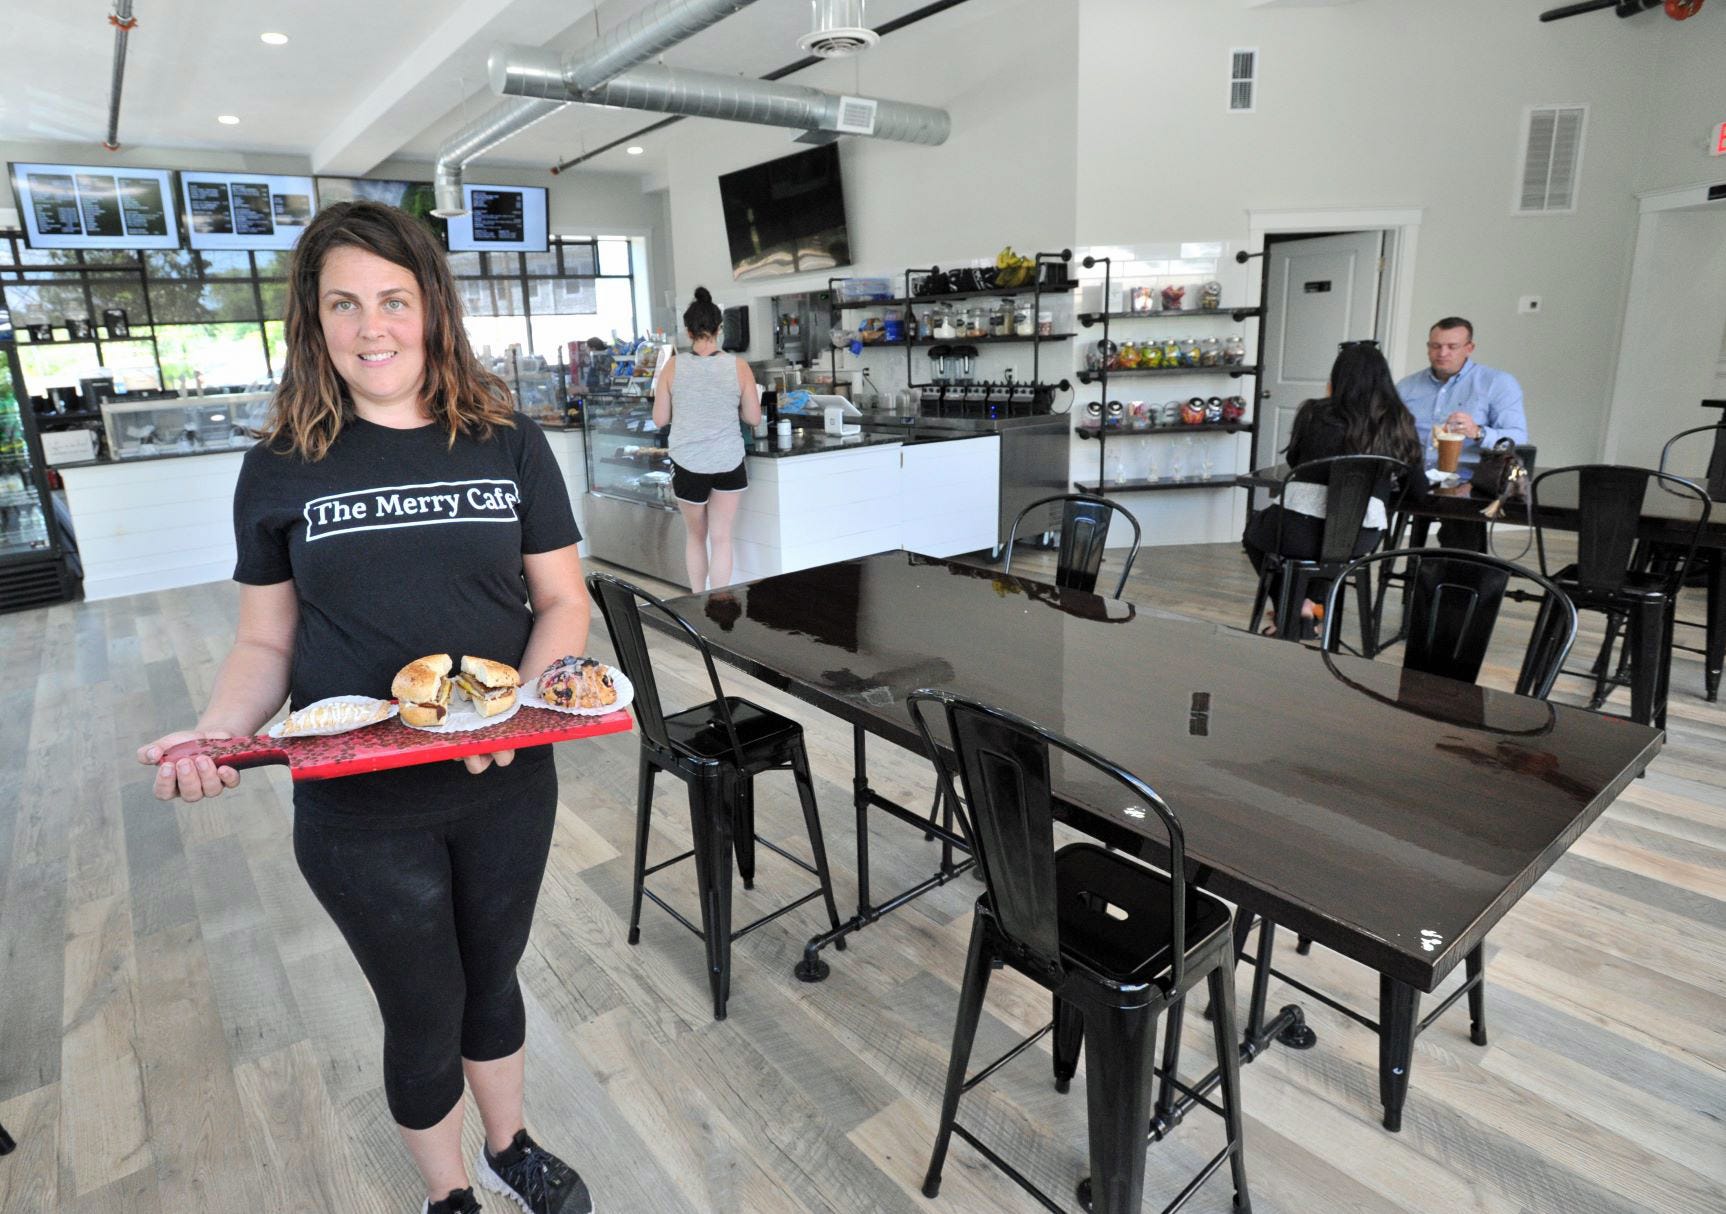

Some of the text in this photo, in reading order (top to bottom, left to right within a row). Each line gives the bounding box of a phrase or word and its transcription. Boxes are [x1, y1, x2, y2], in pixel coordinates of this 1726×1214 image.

[312, 487, 518, 525] The Merry Cafe
